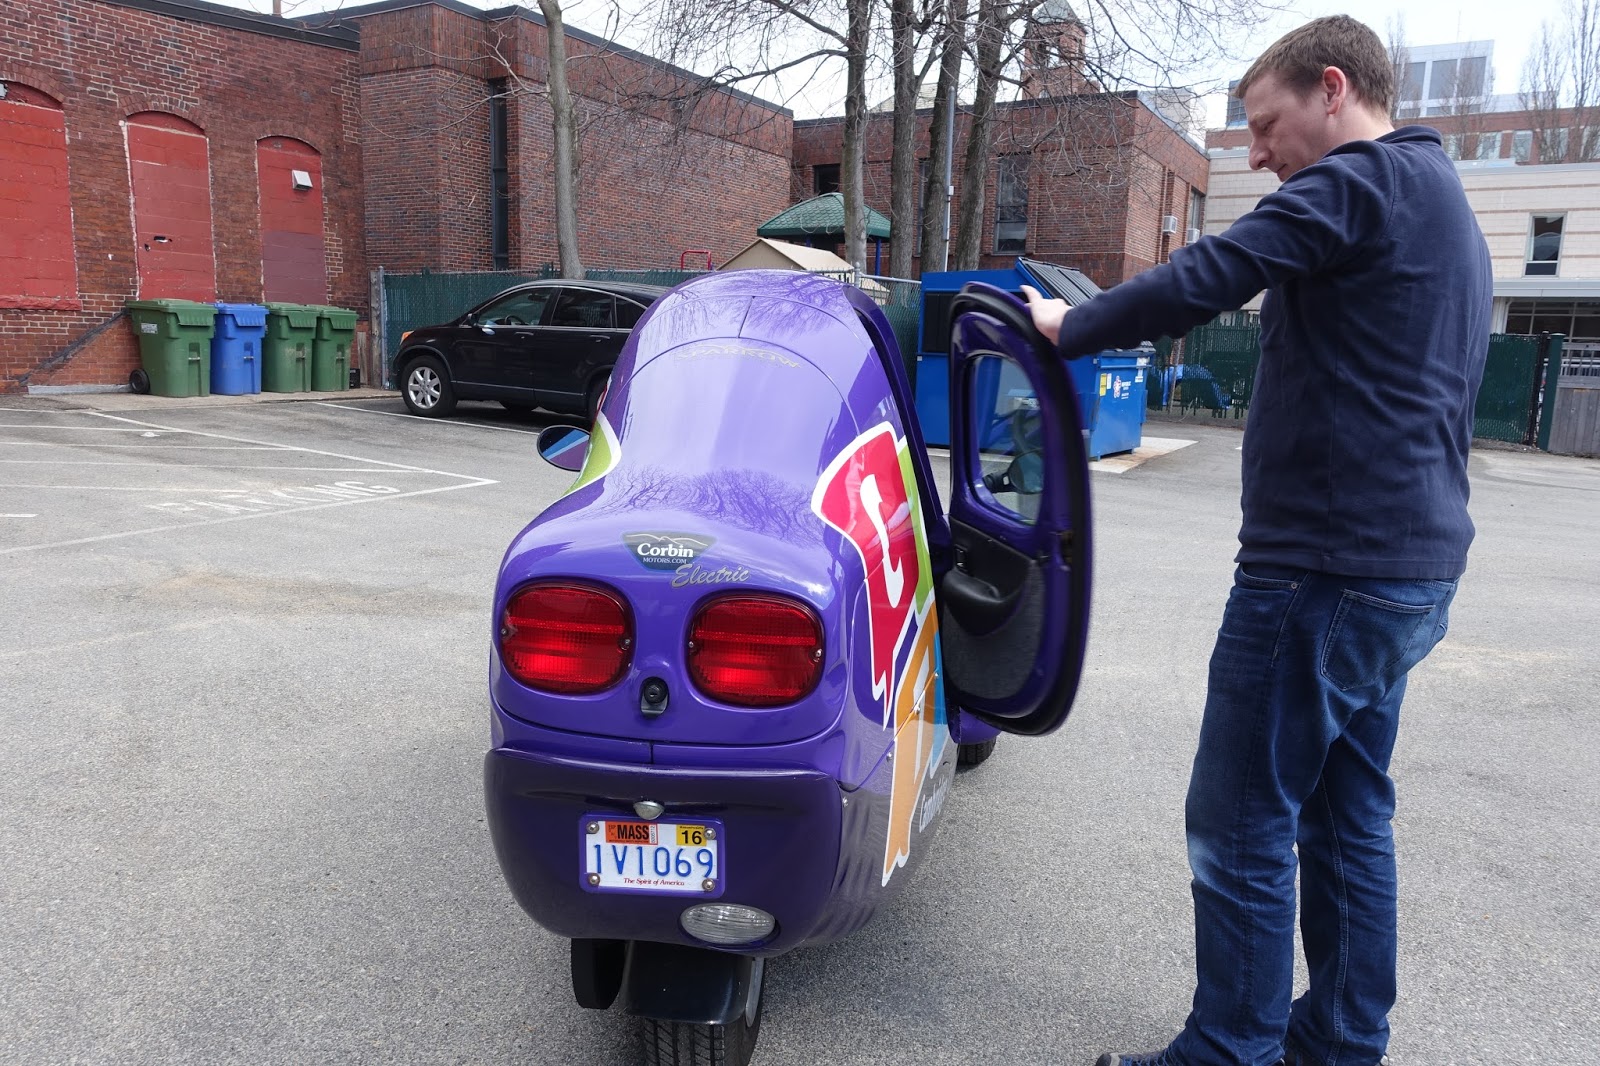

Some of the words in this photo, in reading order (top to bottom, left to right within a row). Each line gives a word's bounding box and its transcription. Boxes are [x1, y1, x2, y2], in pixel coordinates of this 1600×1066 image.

[637, 543, 693, 557] Corbin
[671, 563, 750, 588] Electric
[617, 824, 650, 840] MASS
[681, 830, 702, 845] 16
[594, 844, 713, 878] 1V1069
